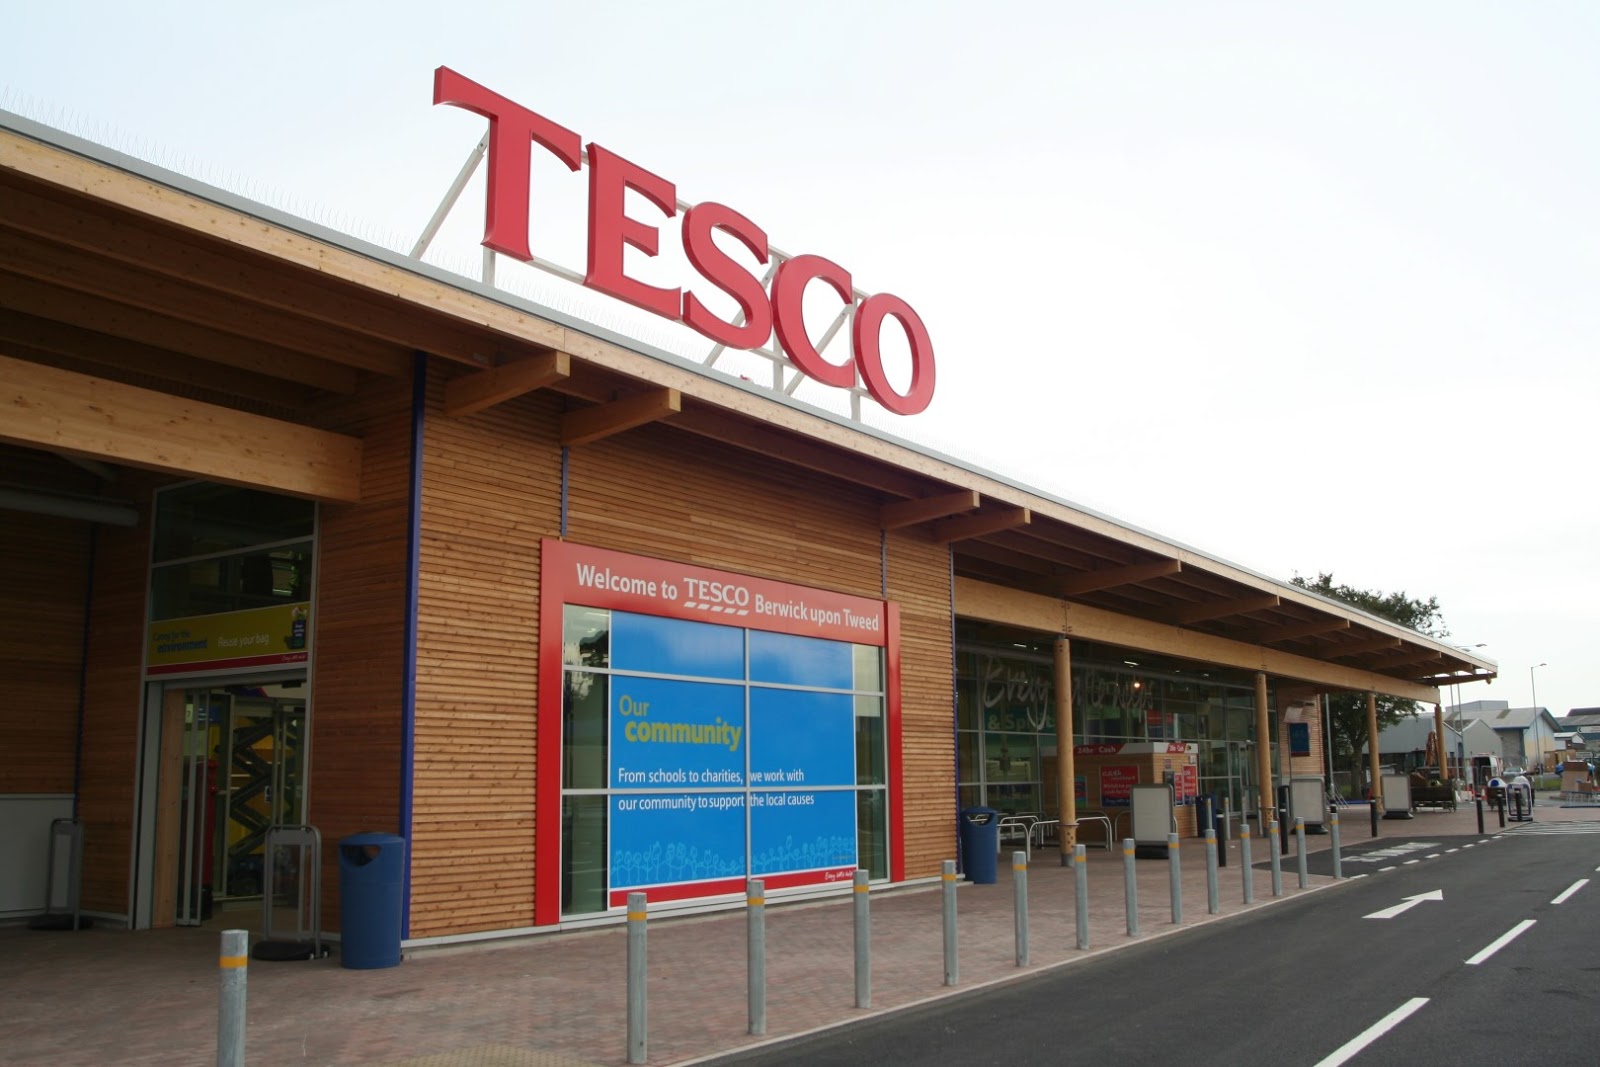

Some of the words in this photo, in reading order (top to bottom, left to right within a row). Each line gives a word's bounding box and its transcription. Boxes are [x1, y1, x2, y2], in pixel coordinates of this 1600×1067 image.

[433, 66, 936, 415] TESCO
[576, 562, 657, 597] Welcome
[661, 580, 678, 600] to
[683, 577, 749, 607] TESCO
[755, 594, 808, 621] Berwick
[810, 607, 841, 626] upon
[843, 608, 879, 631] Tweed
[218, 636, 239, 648] Reuse
[239, 636, 255, 648] your
[255, 632, 270, 646] bag
[619, 695, 649, 717] Our
[983, 655, 1049, 730] Every
[625, 716, 743, 752] community
[618, 767, 646, 783] From
[649, 768, 687, 783] schools
[689, 770, 699, 783] to
[701, 768, 743, 785] charities,
[750, 771, 762, 782] we
[764, 769, 785, 782] work
[786, 768, 804, 782] with
[618, 799, 637, 811] our
[639, 795, 697, 812] community
[698, 795, 708, 808] to
[709, 795, 745, 811] support
[750, 793, 764, 807] the
[766, 793, 786, 806] local
[787, 795, 814, 806] causes
